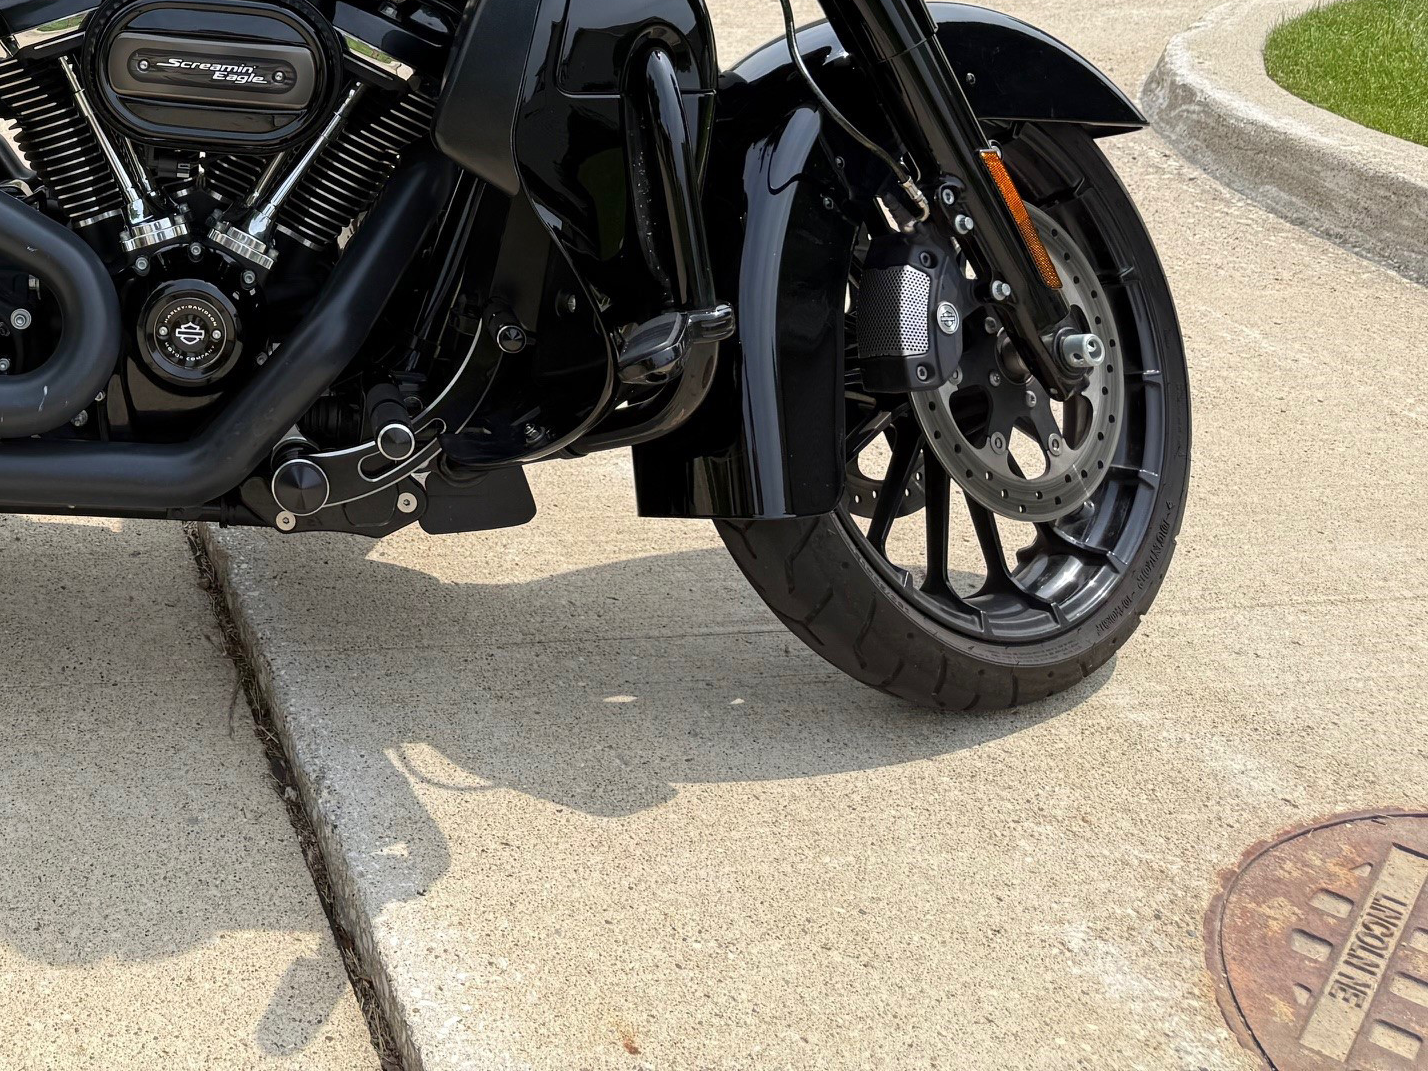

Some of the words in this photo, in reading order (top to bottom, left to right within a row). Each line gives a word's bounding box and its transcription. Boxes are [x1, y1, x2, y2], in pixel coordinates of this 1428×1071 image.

[156, 58, 258, 74] Screamin'
[212, 71, 268, 84] Eagle
[164, 341, 184, 360] MOTOR
[186, 345, 216, 361] COMPANY
[1343, 891, 1408, 977] LINCOLN
[1327, 971, 1372, 1009] NE
